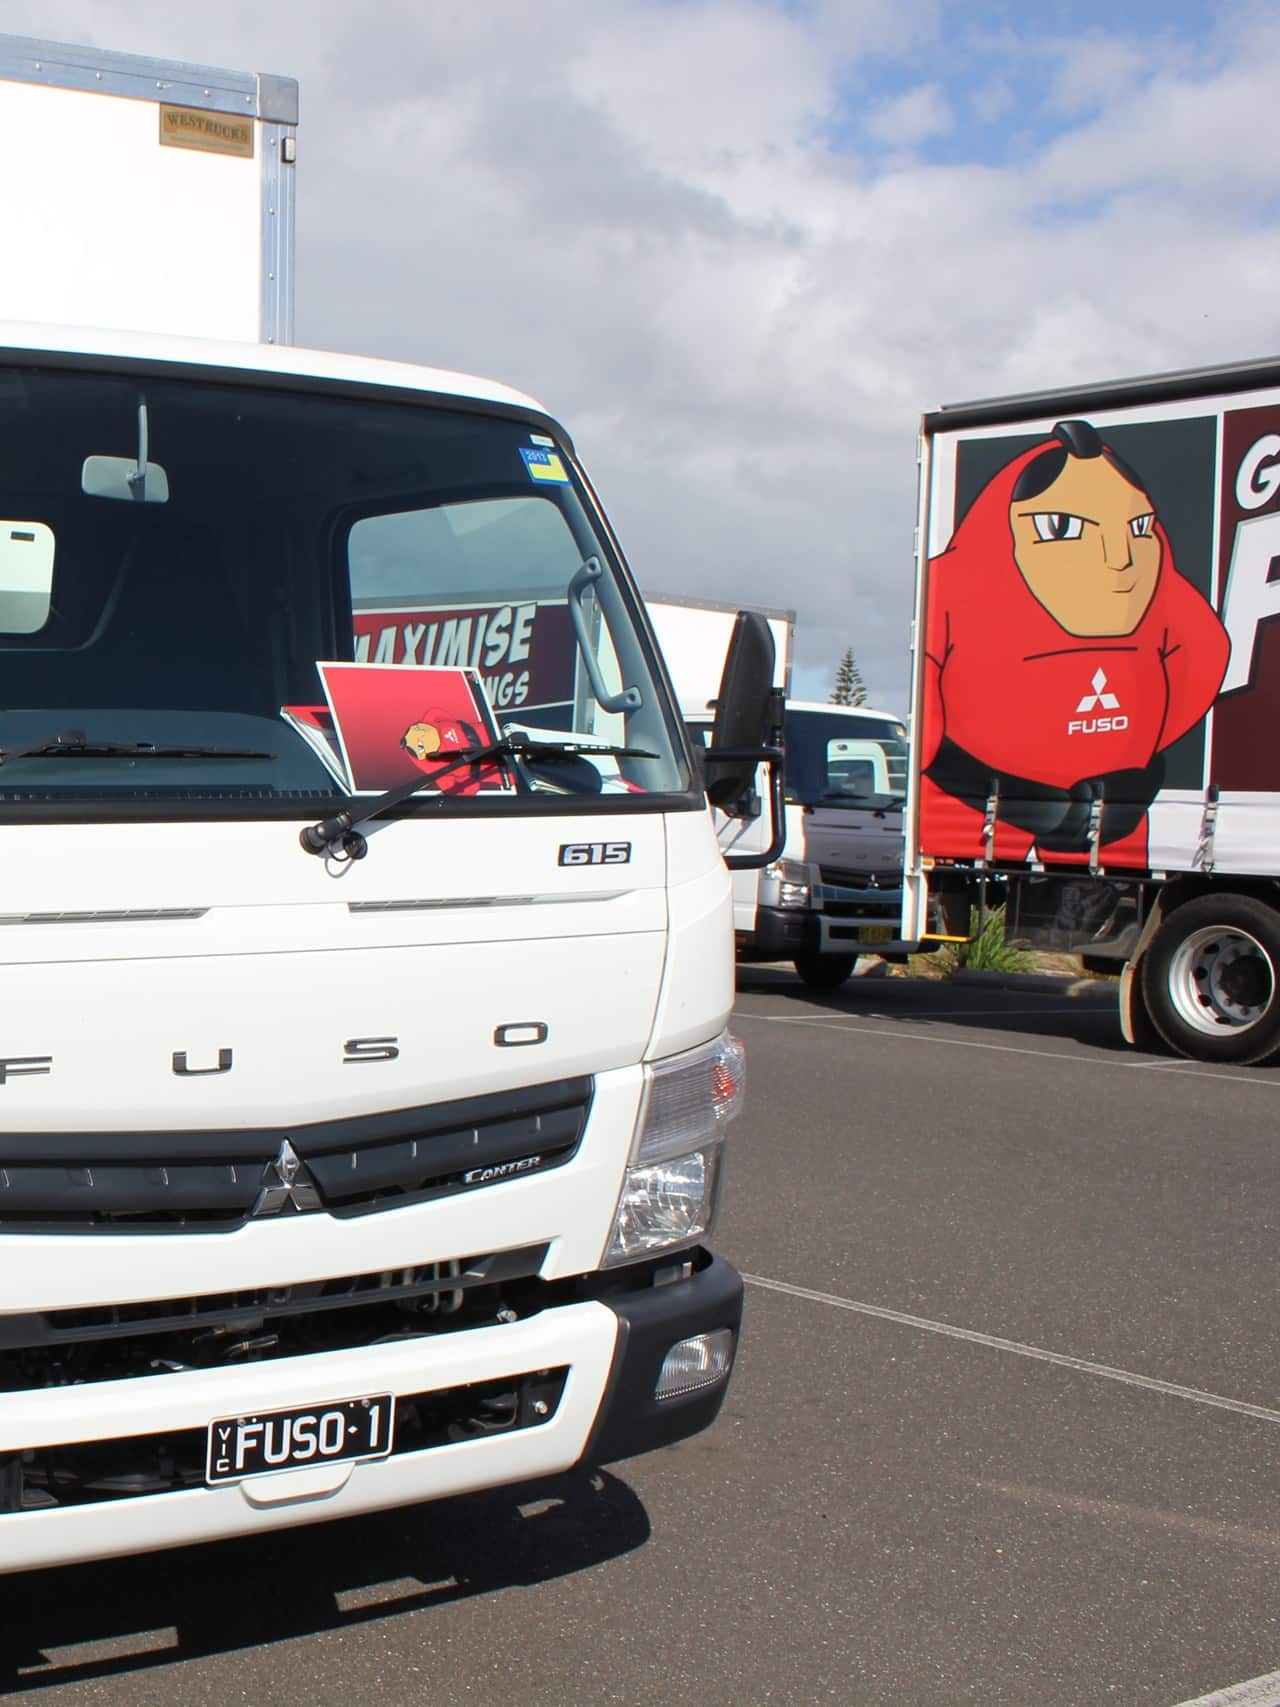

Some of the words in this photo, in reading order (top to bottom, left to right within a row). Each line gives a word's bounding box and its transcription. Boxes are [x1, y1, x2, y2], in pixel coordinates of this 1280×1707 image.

[166, 111, 249, 141] WESTRUCKS
[1235, 434, 1280, 511] G
[1068, 716, 1128, 736] FUSO
[560, 841, 631, 866] 615
[216, 1426, 231, 1472] VIC
